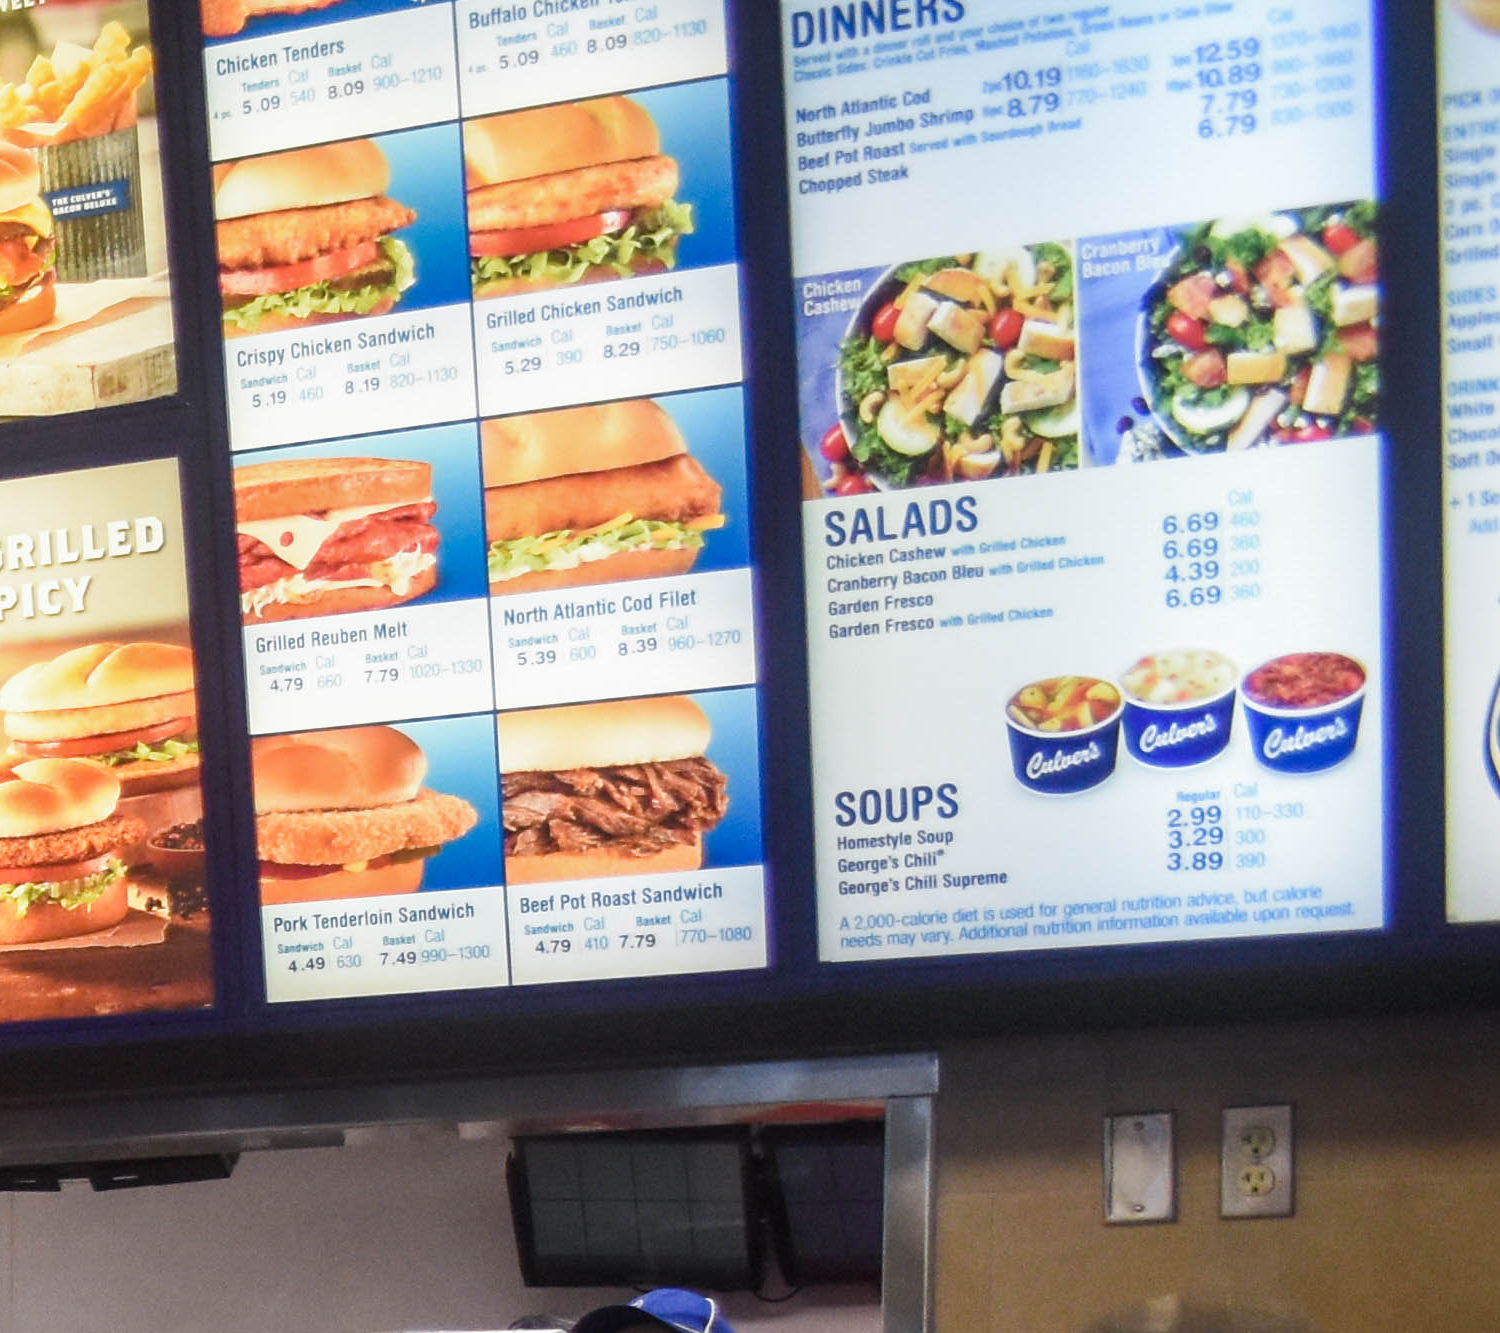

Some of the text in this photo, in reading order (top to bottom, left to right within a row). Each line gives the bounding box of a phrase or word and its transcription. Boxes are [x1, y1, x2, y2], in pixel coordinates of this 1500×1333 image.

[791, 0, 965, 49] DINNERS
[1194, 39, 1259, 65] 12.59
[486, 286, 682, 328] Grilled Chicken Sandwich
[237, 324, 434, 368] Crispy Chicken Sandwich
[604, 340, 640, 359] 8.29
[504, 356, 542, 375] 5.29
[825, 495, 978, 548] SALADS
[1162, 511, 1219, 535] 6.69
[826, 543, 946, 571] Chicken Cashew
[1165, 561, 1220, 583] 4.39
[504, 589, 696, 626] North Atlantic Cod Filet
[1139, 715, 1217, 754] Culver's
[1263, 717, 1348, 759] Culver's
[1026, 741, 1100, 781] Culver's
[835, 783, 959, 828] SOUPS
[1168, 804, 1222, 827] 2.99
[837, 828, 954, 853] Homestyle Soup
[1168, 850, 1223, 874] 3.89
[520, 881, 723, 913] Beef Pot Roast Sandwich
